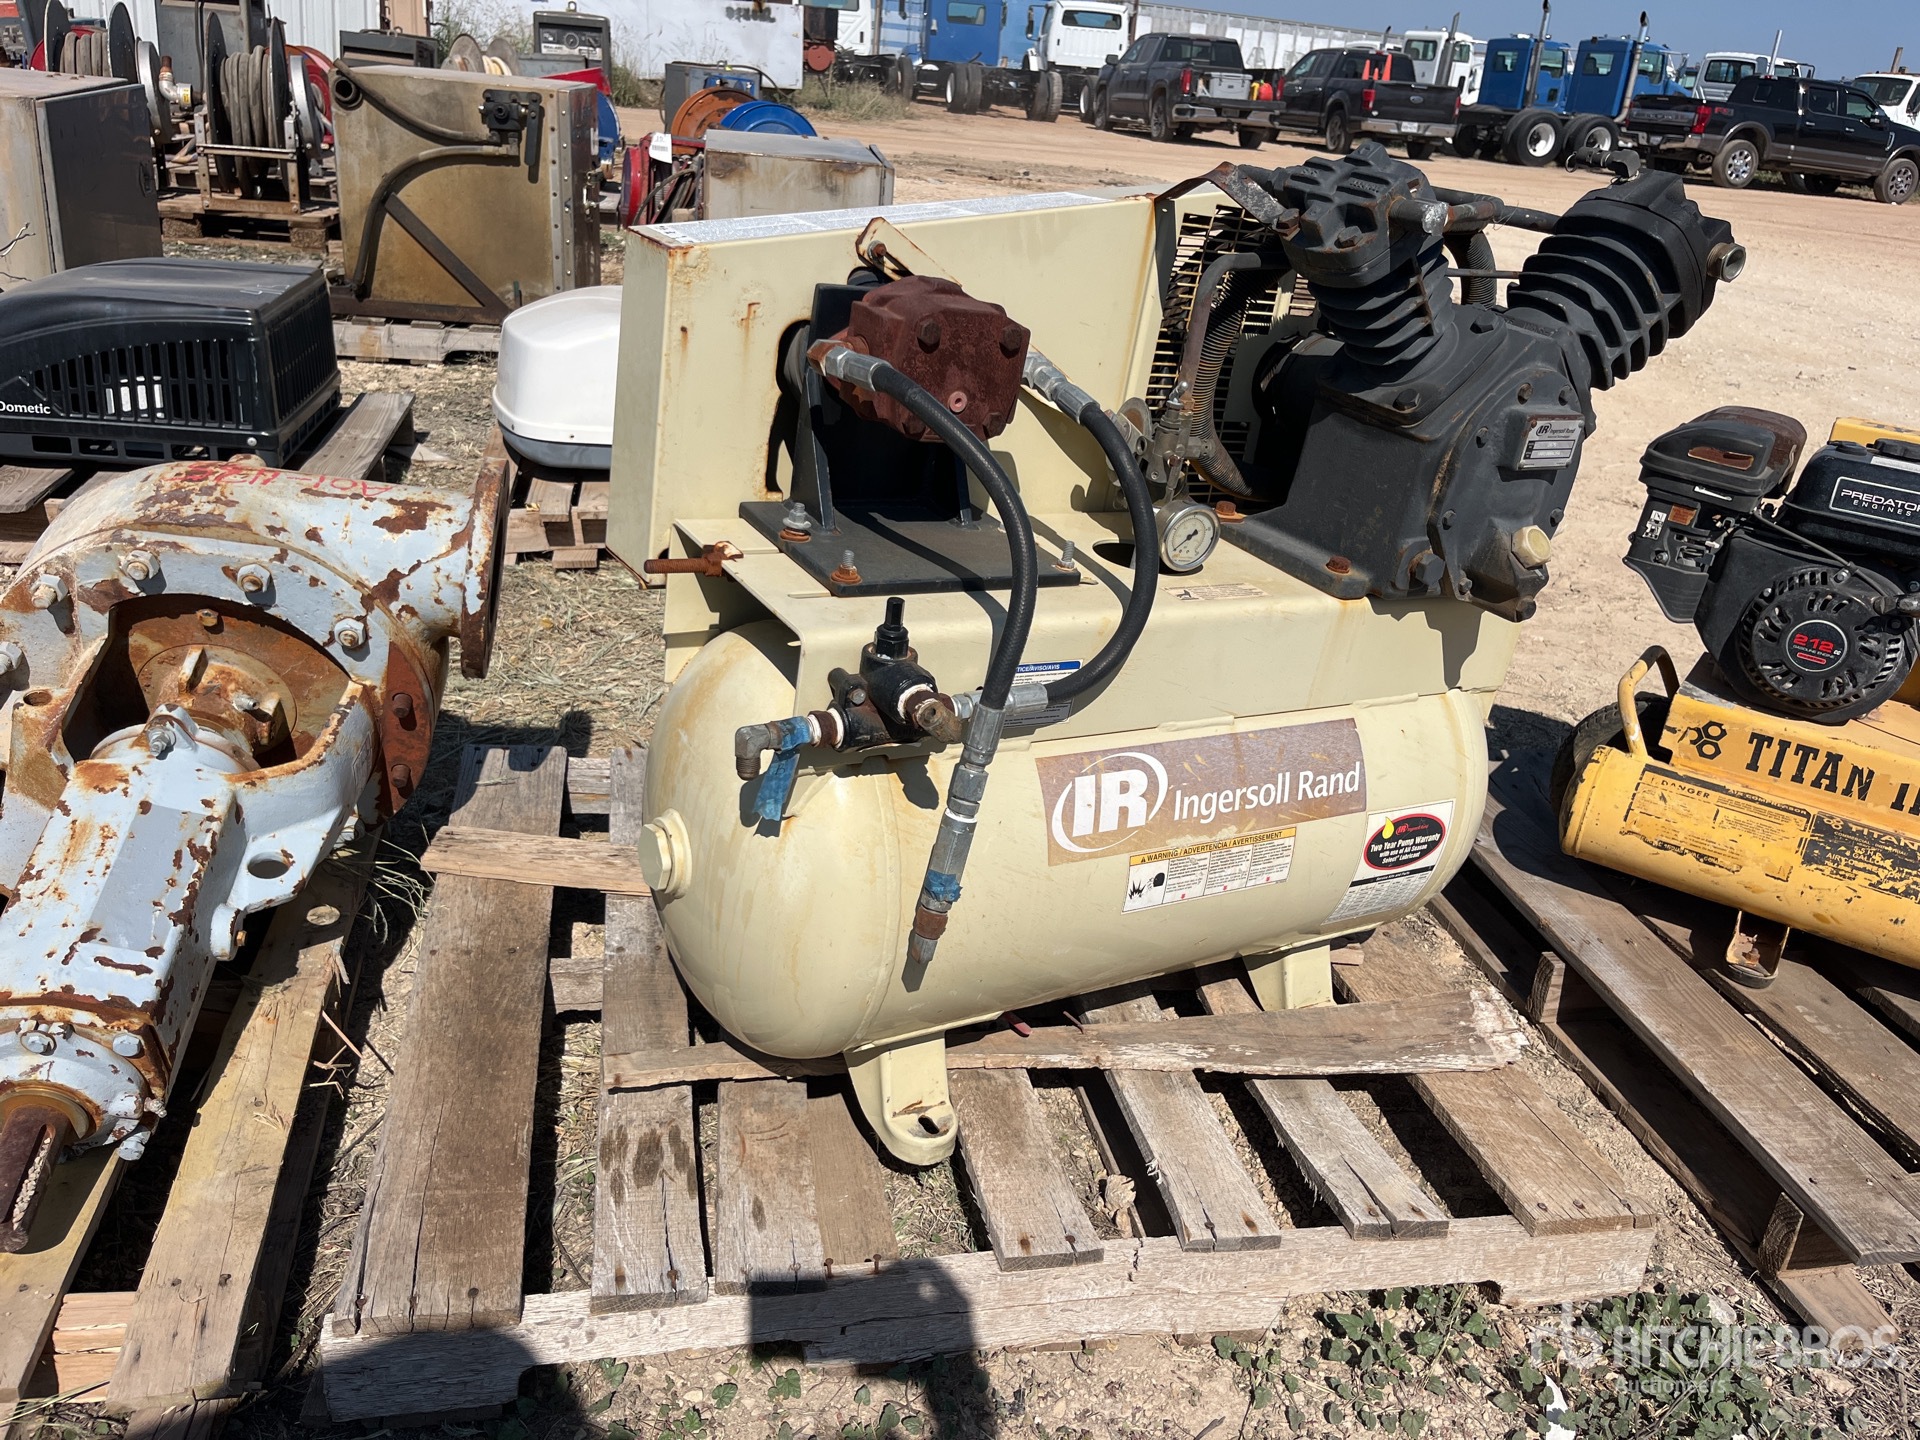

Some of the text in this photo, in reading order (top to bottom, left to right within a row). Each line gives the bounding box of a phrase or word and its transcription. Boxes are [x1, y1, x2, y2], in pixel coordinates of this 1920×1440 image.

[1853, 499, 1912, 517] ENGINES
[1793, 633, 1834, 654] 212
[1016, 664, 1061, 673] TICE/AVISO/AVIS
[1745, 731, 1876, 801] TITAN
[1072, 761, 1361, 838] IR Ingersoll Rand
[1660, 779, 1711, 800] DANGER
[1146, 848, 1179, 862] WARNING
[1183, 841, 1228, 855] ADVERTENCIA
[1232, 831, 1283, 848] AVERTISSEMENT
[1370, 832, 1441, 853] Two Year Pump Warranty
[1848, 822, 1920, 851] TITAN
[1379, 850, 1390, 858] with
[1411, 844, 1428, 852] Season
